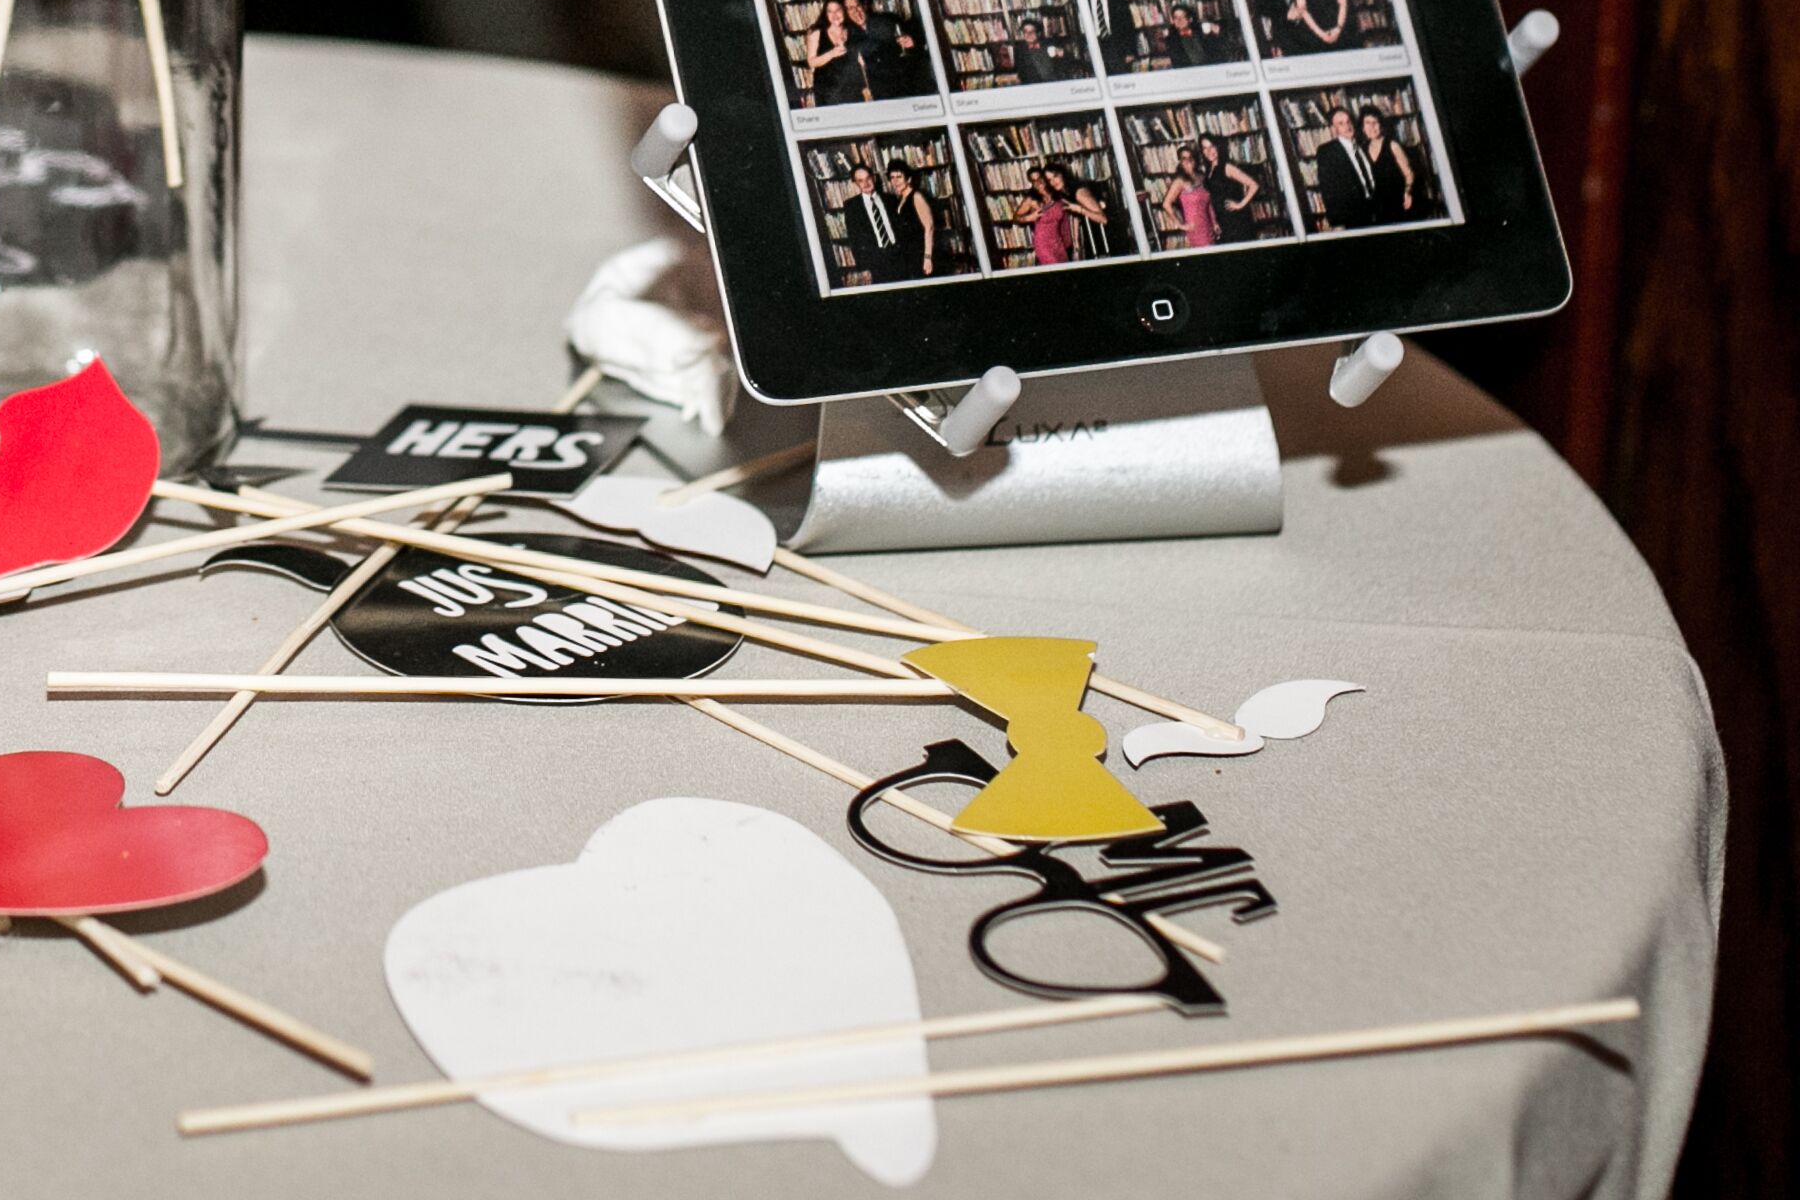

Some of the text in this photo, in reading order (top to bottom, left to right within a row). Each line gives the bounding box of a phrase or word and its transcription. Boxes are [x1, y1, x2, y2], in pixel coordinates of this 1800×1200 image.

[1070, 85, 1095, 95] Delete
[912, 102, 938, 112] Delete
[956, 98, 979, 107] Share
[796, 115, 820, 124] Share
[386, 419, 605, 470] HERS
[397, 543, 549, 618] JUS
[452, 595, 721, 679] MARRI
